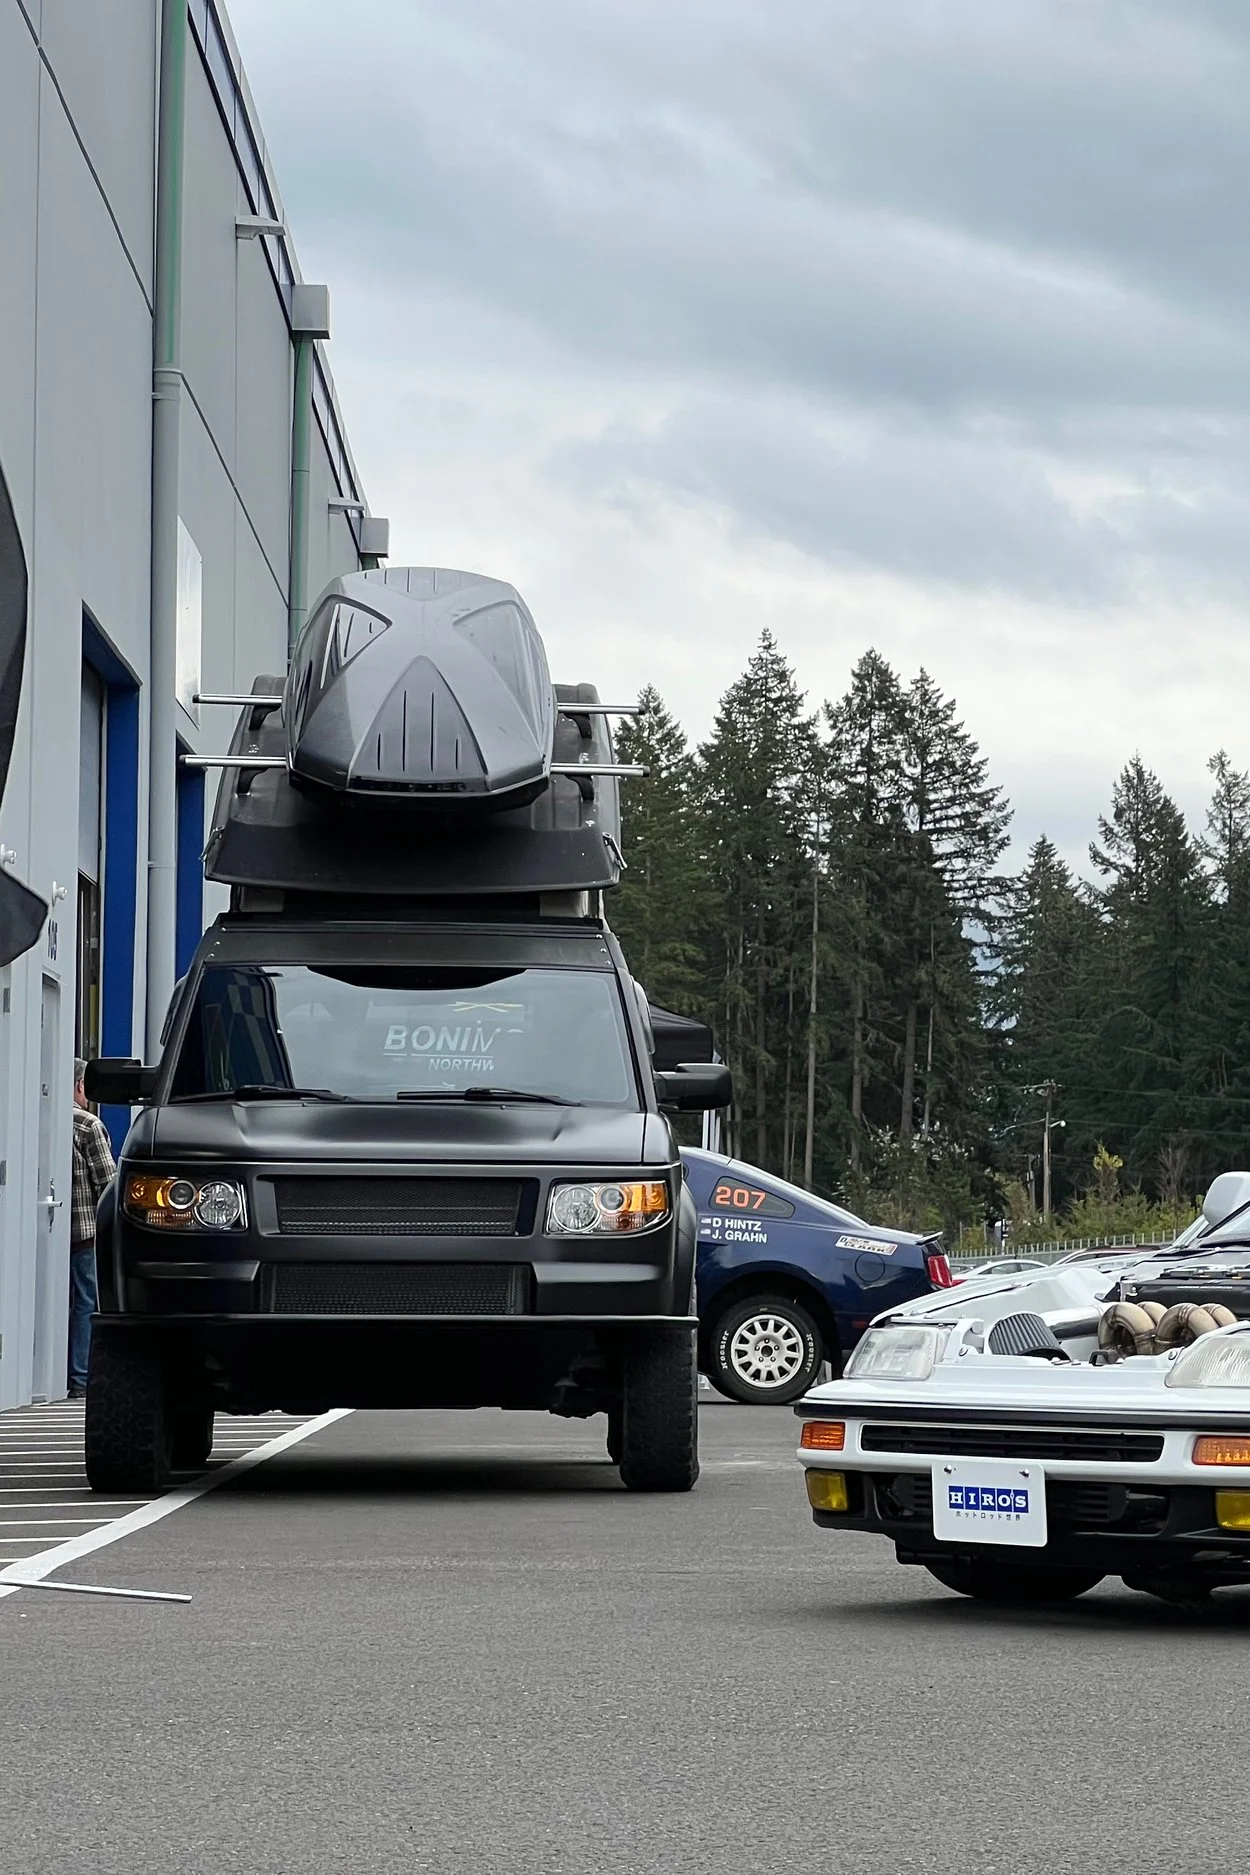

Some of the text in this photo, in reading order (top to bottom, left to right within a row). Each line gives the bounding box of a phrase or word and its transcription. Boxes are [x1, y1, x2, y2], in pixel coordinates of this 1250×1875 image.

[384, 1025, 524, 1052] BONIN
[429, 1058, 494, 1071] NORTHW
[715, 1186, 767, 1210] 207
[712, 1217, 762, 1231] D HINTZ
[711, 1229, 768, 1243] J. GRAHN
